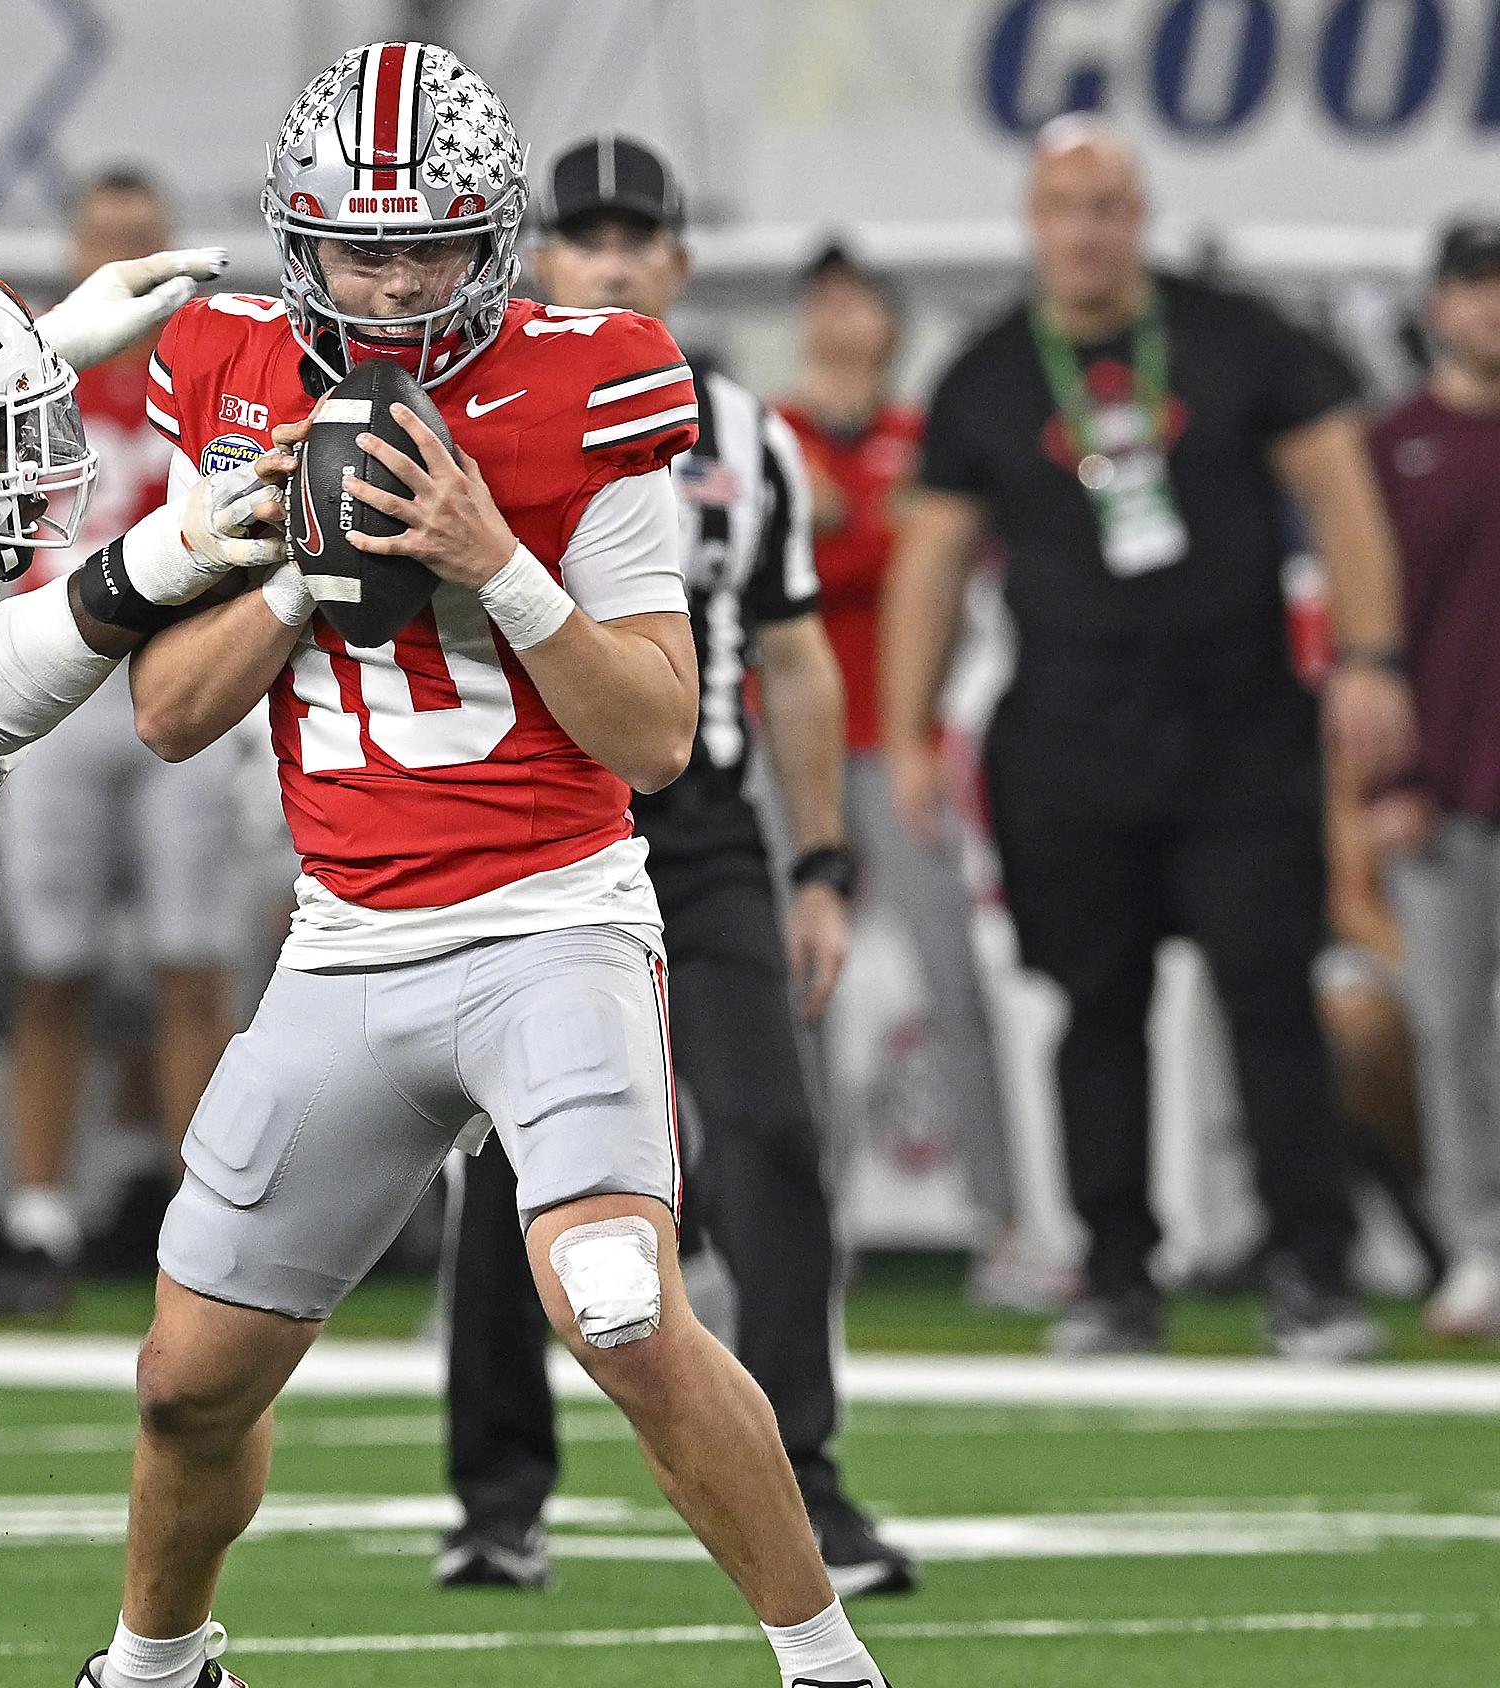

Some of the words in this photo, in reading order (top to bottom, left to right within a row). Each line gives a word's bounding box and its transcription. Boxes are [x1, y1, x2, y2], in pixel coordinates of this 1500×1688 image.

[984, 0, 1500, 140] GOO
[349, 197, 377, 214] OHIO
[382, 196, 418, 213] STATE
[211, 443, 261, 460] GOODYEA
